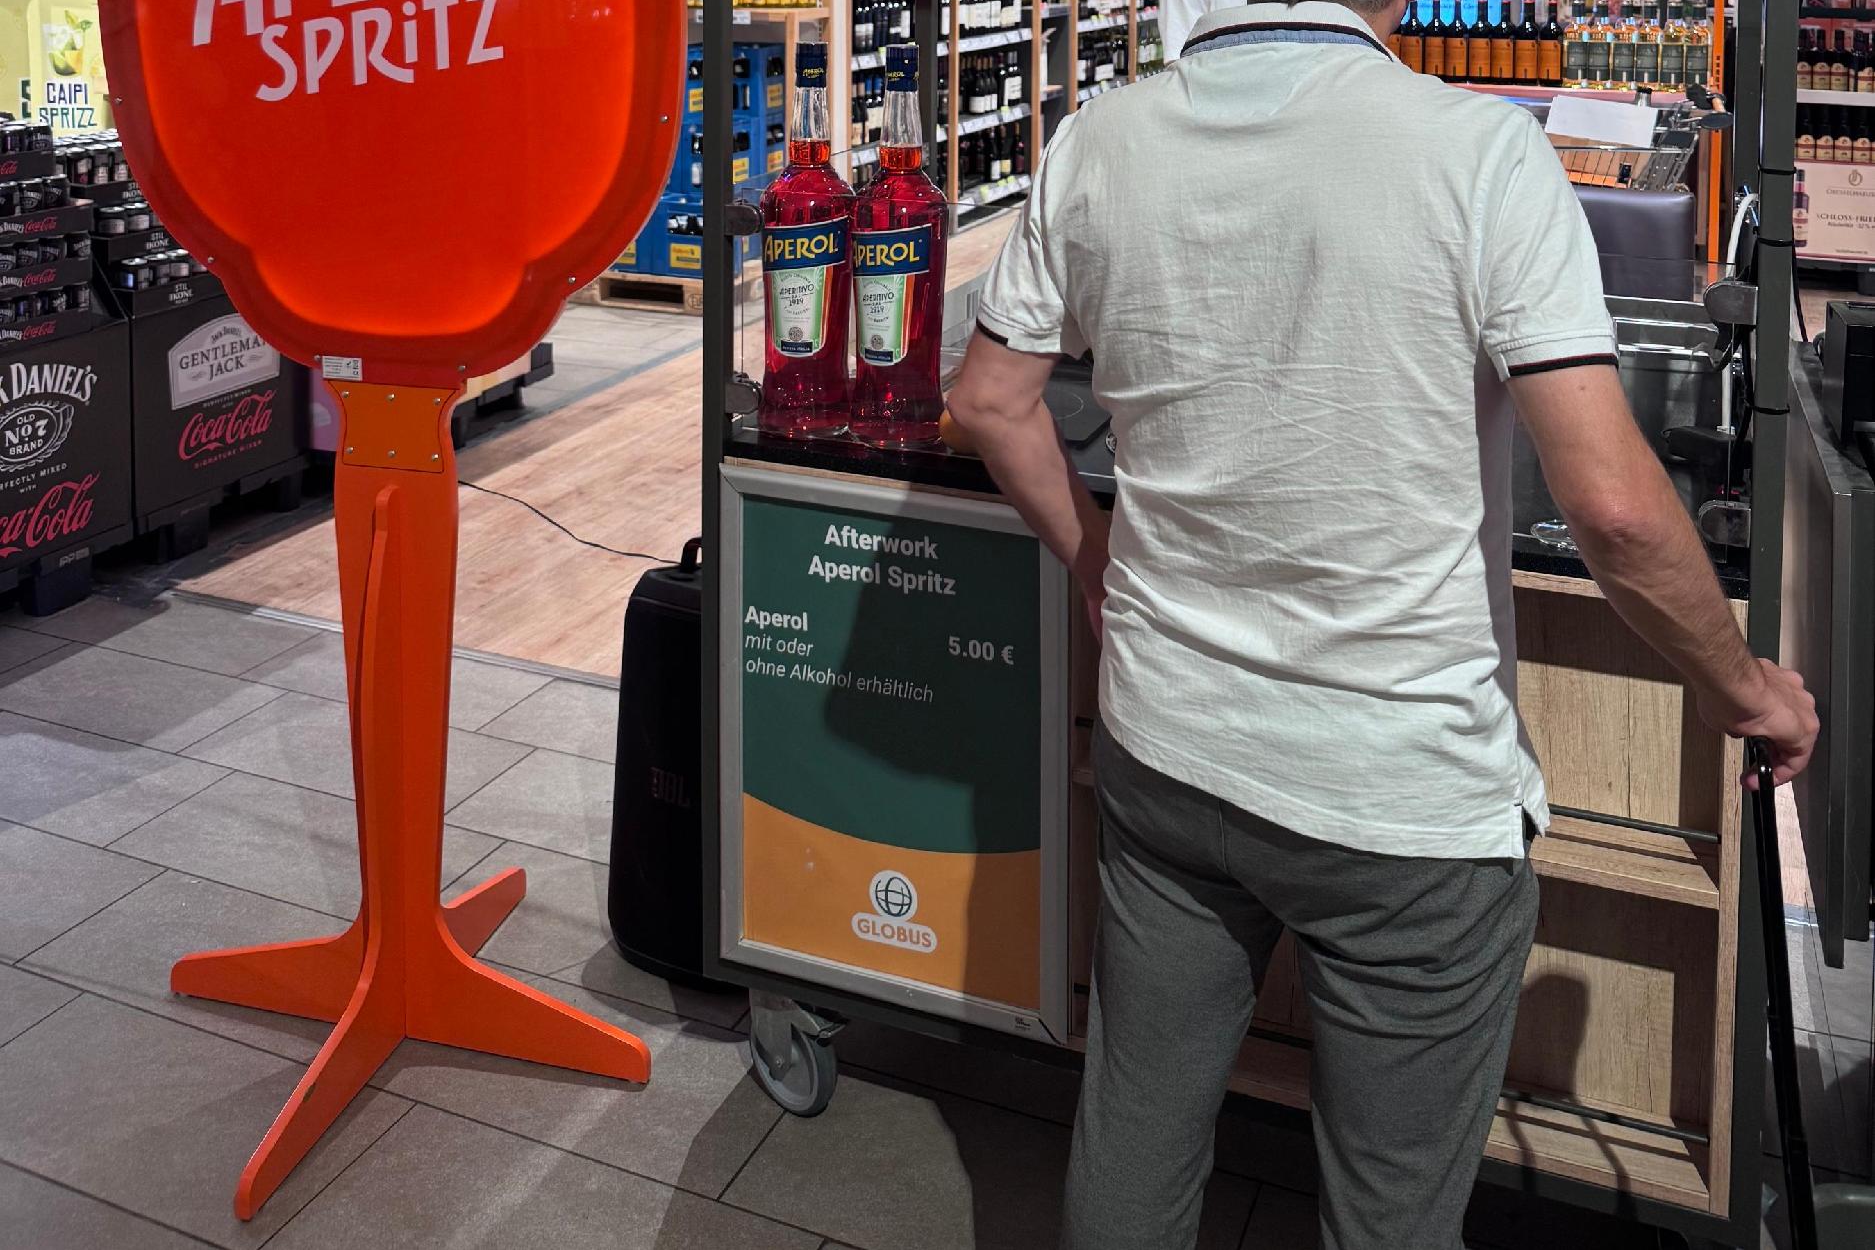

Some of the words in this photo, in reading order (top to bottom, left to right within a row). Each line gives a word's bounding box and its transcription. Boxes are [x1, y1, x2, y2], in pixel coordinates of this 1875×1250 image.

[46, 82, 88, 105] CAIPI
[39, 107, 97, 129] SPRIZZ
[765, 233, 837, 263] APEROL
[9, 362, 98, 402] DANIEL'S
[209, 355, 245, 381] JACK
[17, 414, 36, 425] OLD
[178, 390, 276, 461] Coca-Cola
[9, 439, 44, 455] BRAND
[40, 463, 67, 477] MIXED
[824, 524, 938, 560] Afterwork
[808, 555, 880, 584] Aperol
[887, 565, 956, 595] Spritz
[744, 605, 808, 632] Aperol
[744, 634, 772, 651] mit
[776, 637, 814, 658] oder
[948, 636, 995, 661] 5.00
[1001, 645, 1014, 666] €
[746, 658, 786, 679] ohne
[789, 661, 851, 688] Alkohol
[856, 674, 934, 703] erhältlich
[857, 916, 932, 949] GLOBUS
